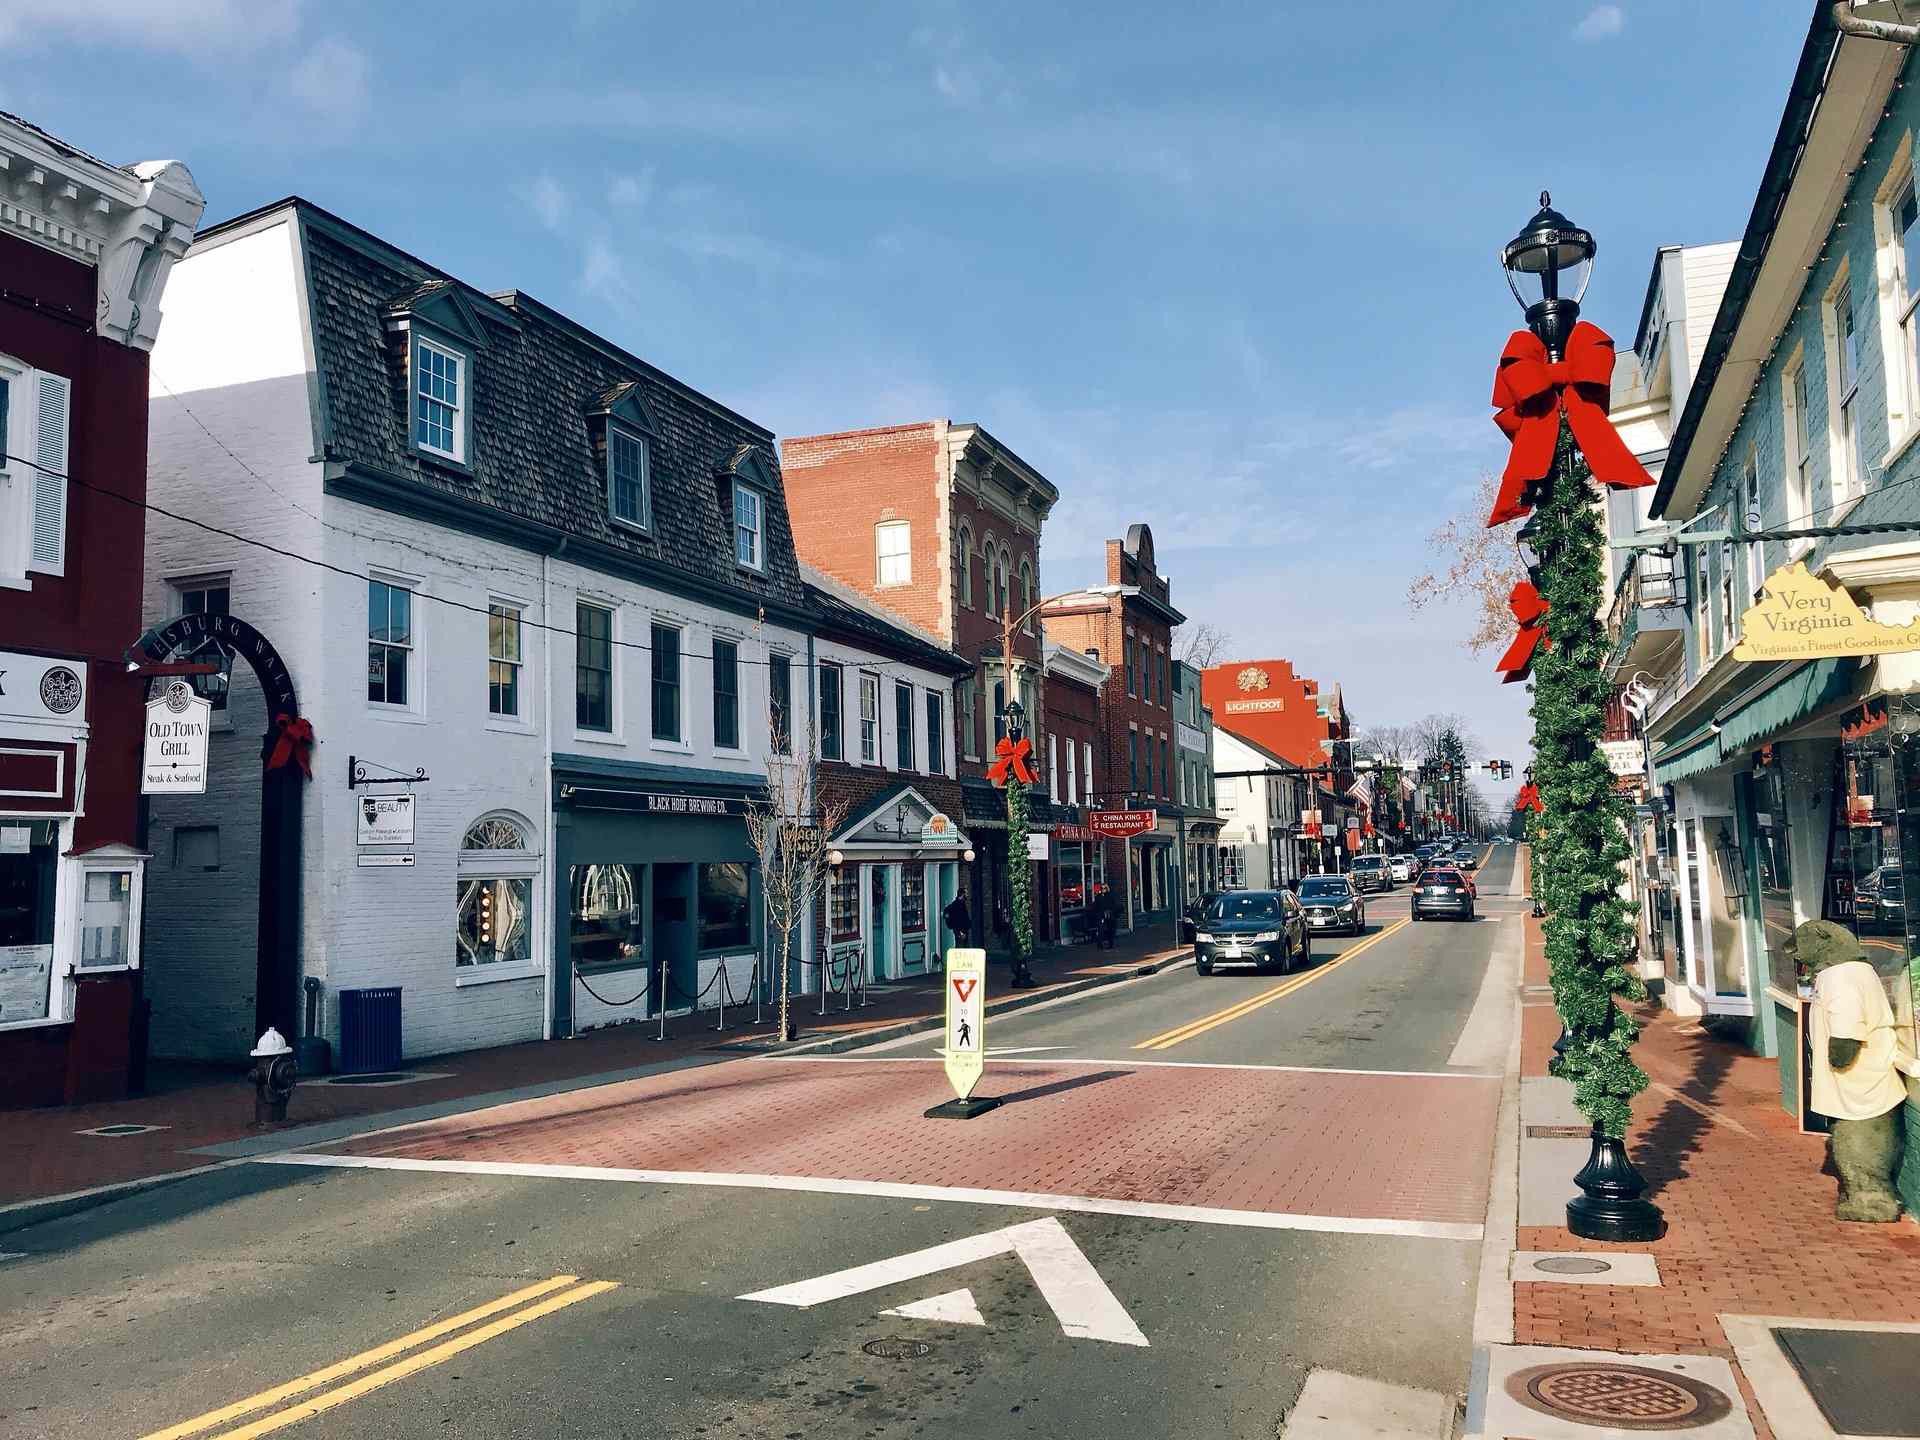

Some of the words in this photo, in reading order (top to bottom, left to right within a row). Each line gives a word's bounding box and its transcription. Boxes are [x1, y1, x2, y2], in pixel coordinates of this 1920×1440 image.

[1778, 591, 1831, 612] Very
[1761, 612, 1853, 635] Virginia
[1751, 643, 1805, 656] Virginia's
[1808, 640, 1842, 651] Finest
[1844, 635, 1894, 648] Goodies
[256, 639, 291, 703] WALK
[1227, 700, 1281, 711] LIGHTFOOT
[150, 722, 171, 738] OLD
[172, 721, 203, 737] TOWN
[160, 740, 190, 756] GRILL
[147, 774, 165, 783] Steak
[166, 775, 173, 783] &
[174, 772, 201, 783] Seafood
[377, 802, 409, 813] BEAUTY
[648, 795, 670, 810] BLACK
[671, 797, 687, 811] HOOF
[688, 798, 716, 813] BREWING
[717, 800, 728, 813] CO.
[1061, 824, 1079, 839] CHINA
[1100, 821, 1145, 829] RESTAURANT
